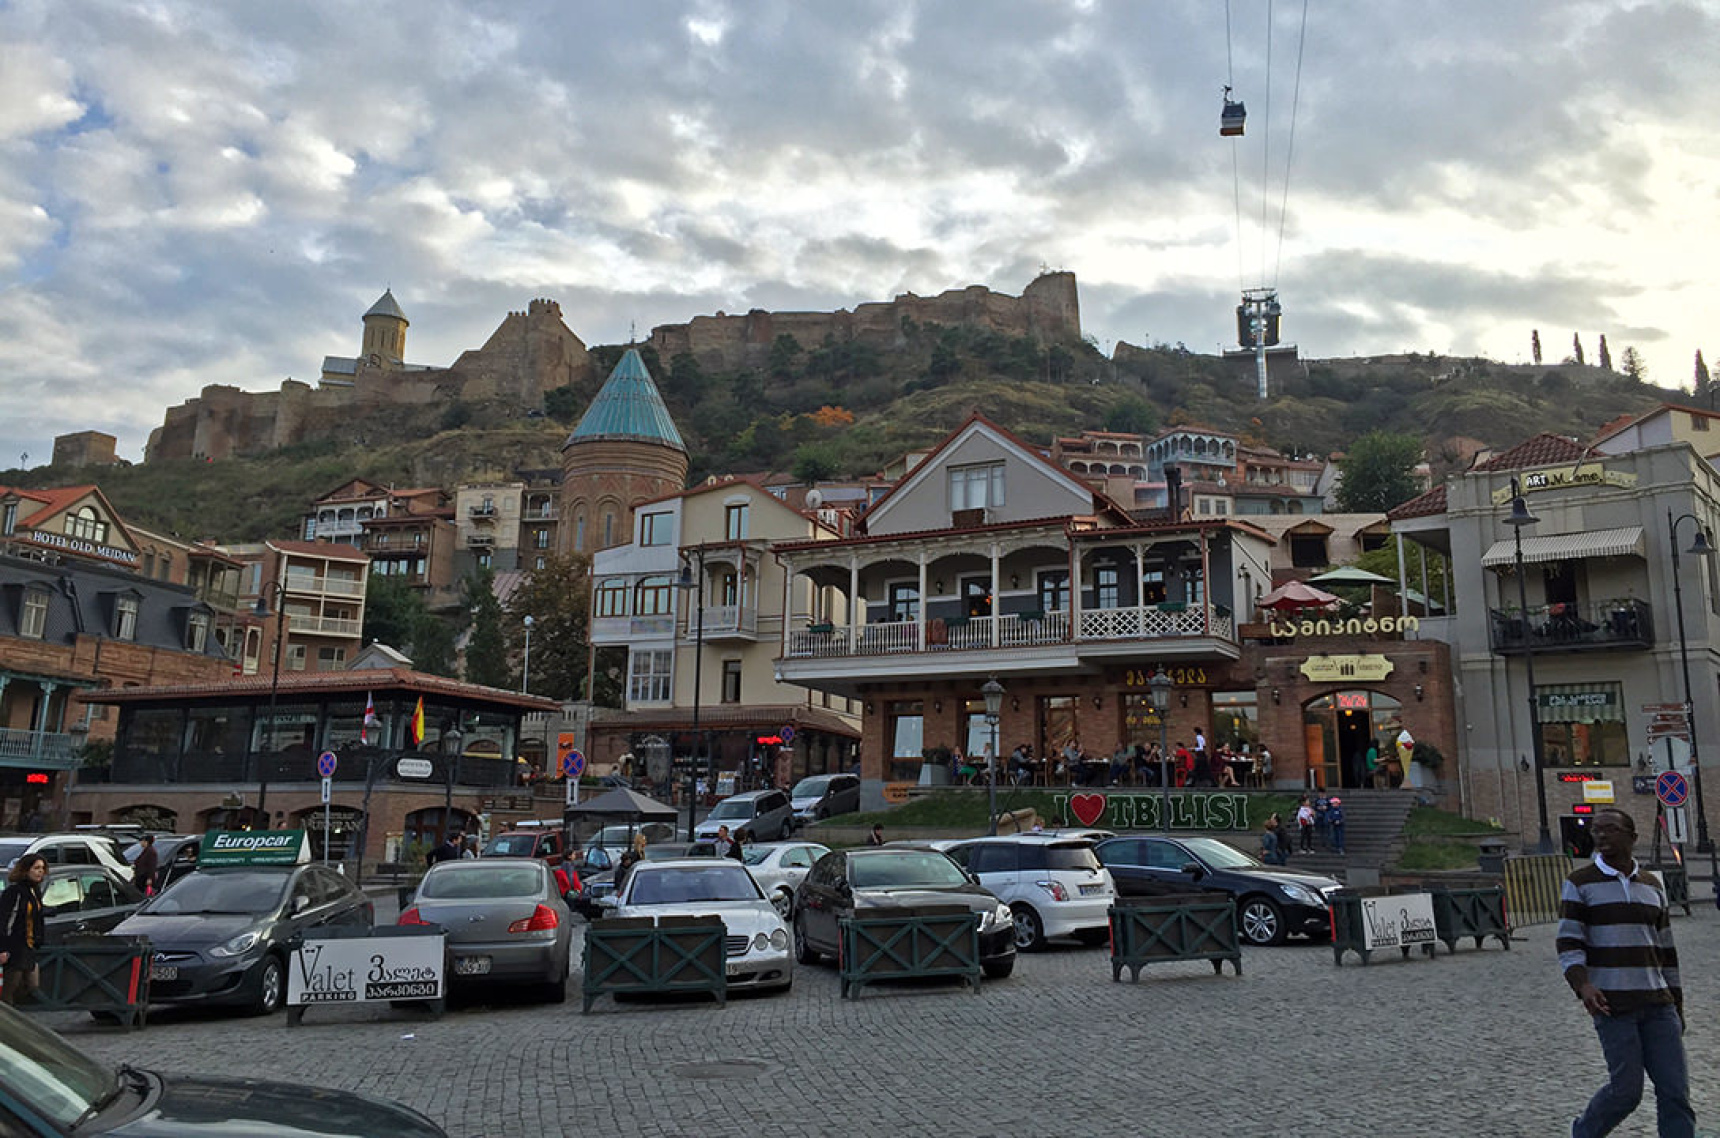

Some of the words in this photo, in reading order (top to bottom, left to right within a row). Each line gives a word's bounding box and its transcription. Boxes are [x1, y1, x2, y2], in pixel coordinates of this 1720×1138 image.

[1526, 475, 1546, 487] ART
[33, 531, 66, 547] HOTEL
[70, 540, 92, 552] OLD
[96, 545, 135, 561] MEIDAN
[1270, 615, 1419, 638] სამიკიტნო
[1107, 794, 1249, 829] TBILISI
[213, 834, 294, 850] Europcar
[1363, 901, 1397, 938] Valet
[299, 945, 355, 991] Valet
[301, 992, 355, 1001] PARKING
